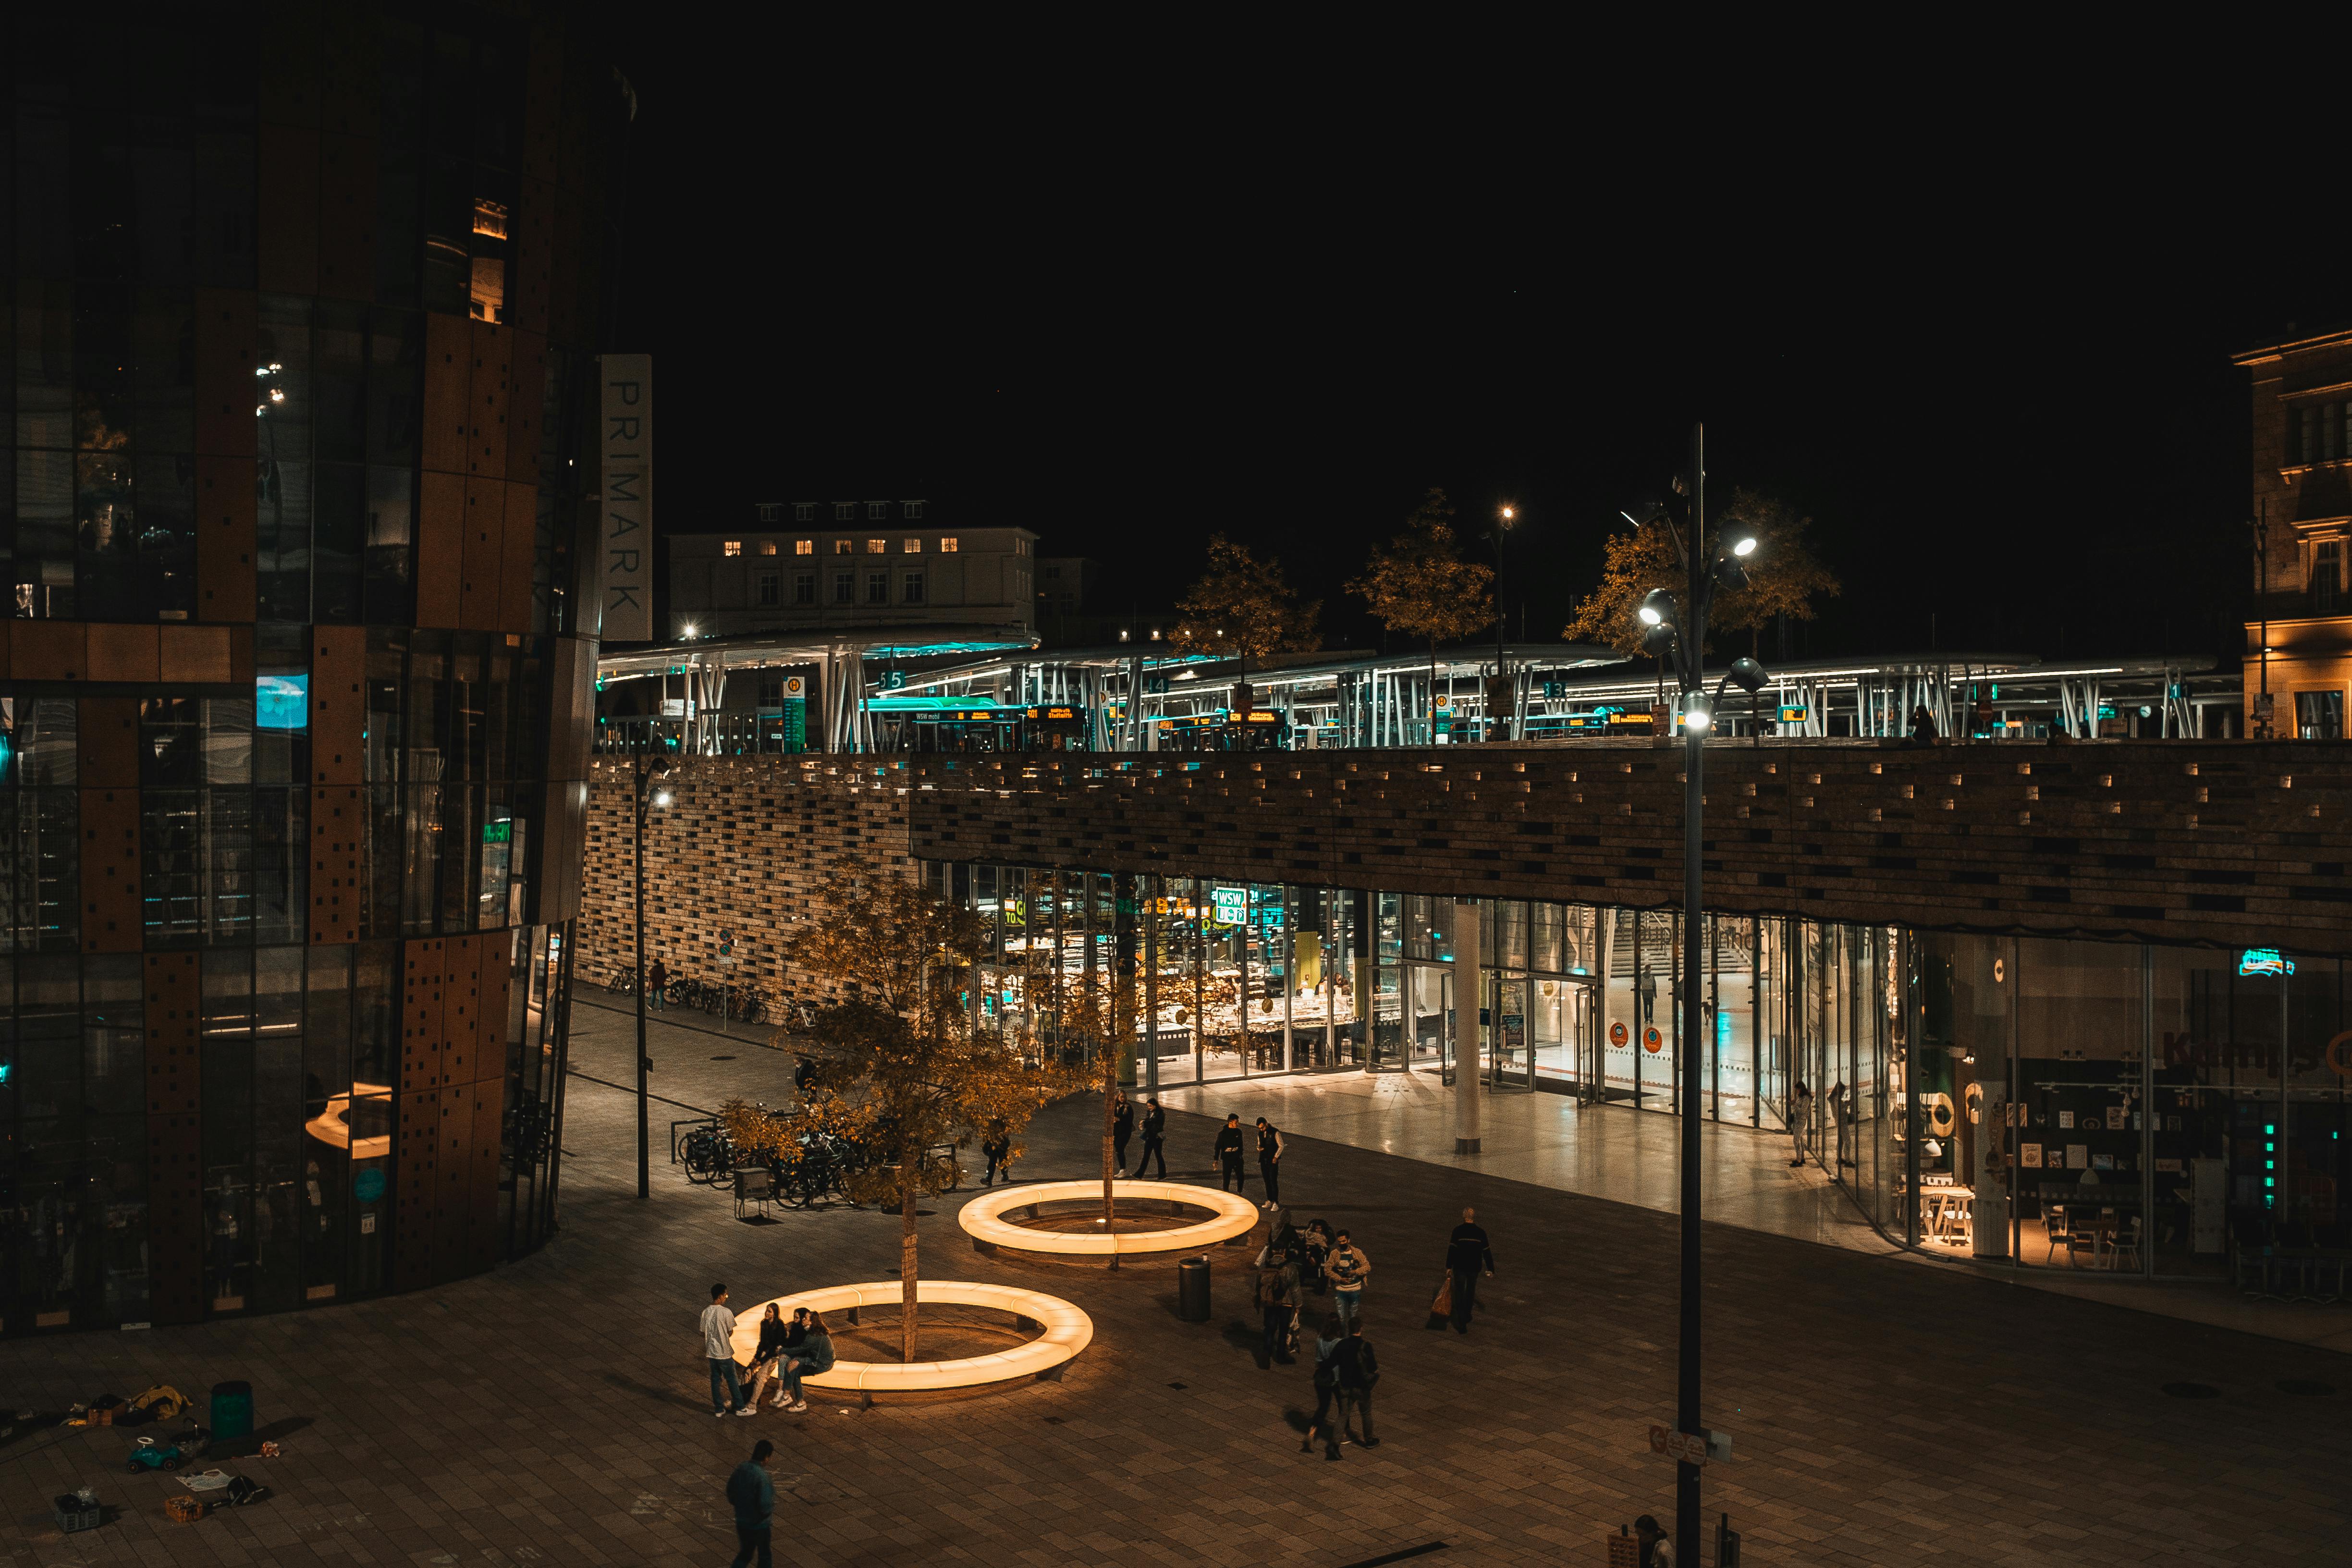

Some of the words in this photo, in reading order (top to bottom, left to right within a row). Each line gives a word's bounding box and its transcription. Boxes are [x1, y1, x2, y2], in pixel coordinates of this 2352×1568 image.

[609, 381, 640, 611] PRIMARK
[881, 673, 886, 687] 5
[892, 672, 901, 687] 5
[1155, 679, 1164, 692] 4
[1545, 683, 1549, 697] 3
[1554, 683, 1562, 697] 3
[2172, 685, 2178, 697] 1
[1027, 709, 1038, 718] 601
[1219, 892, 1241, 906] WSW
[1006, 912, 1016, 924] TO
